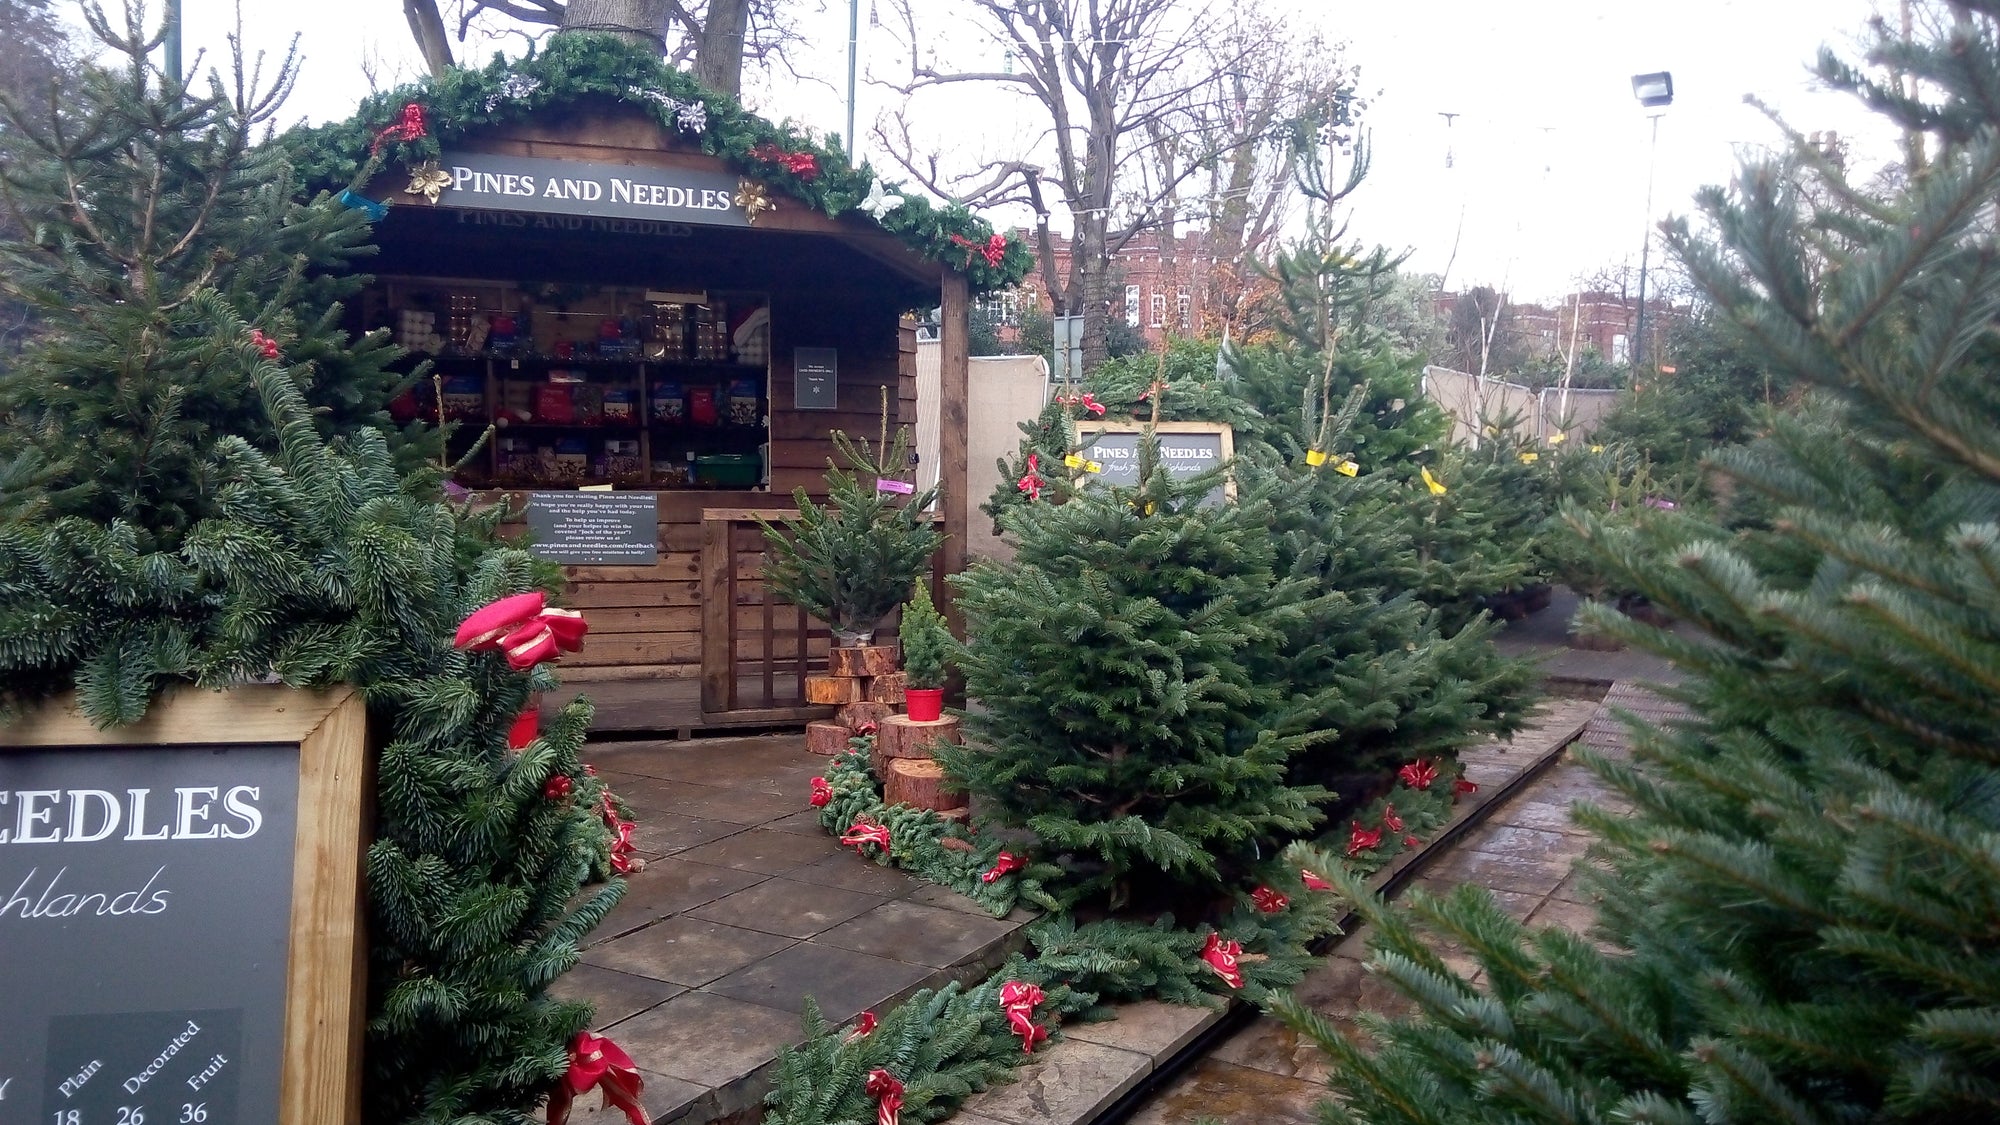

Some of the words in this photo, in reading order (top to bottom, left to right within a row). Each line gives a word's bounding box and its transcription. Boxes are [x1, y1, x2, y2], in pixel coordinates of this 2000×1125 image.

[452, 166, 536, 196] PINES
[542, 177, 602, 201] AND
[610, 178, 731, 211] NEEDLES
[1093, 446, 1129, 459] PINES
[1159, 446, 1213, 458] NEEDLES
[0, 785, 263, 844] EDLES
[0, 864, 173, 919] hlands
[121, 1020, 201, 1095] Decorated
[185, 1052, 228, 1092] Fruit
[58, 1059, 105, 1099] Plain
[53, 1109, 80, 1125] 18
[116, 1105, 144, 1125] 26
[179, 1102, 208, 1124] 36
